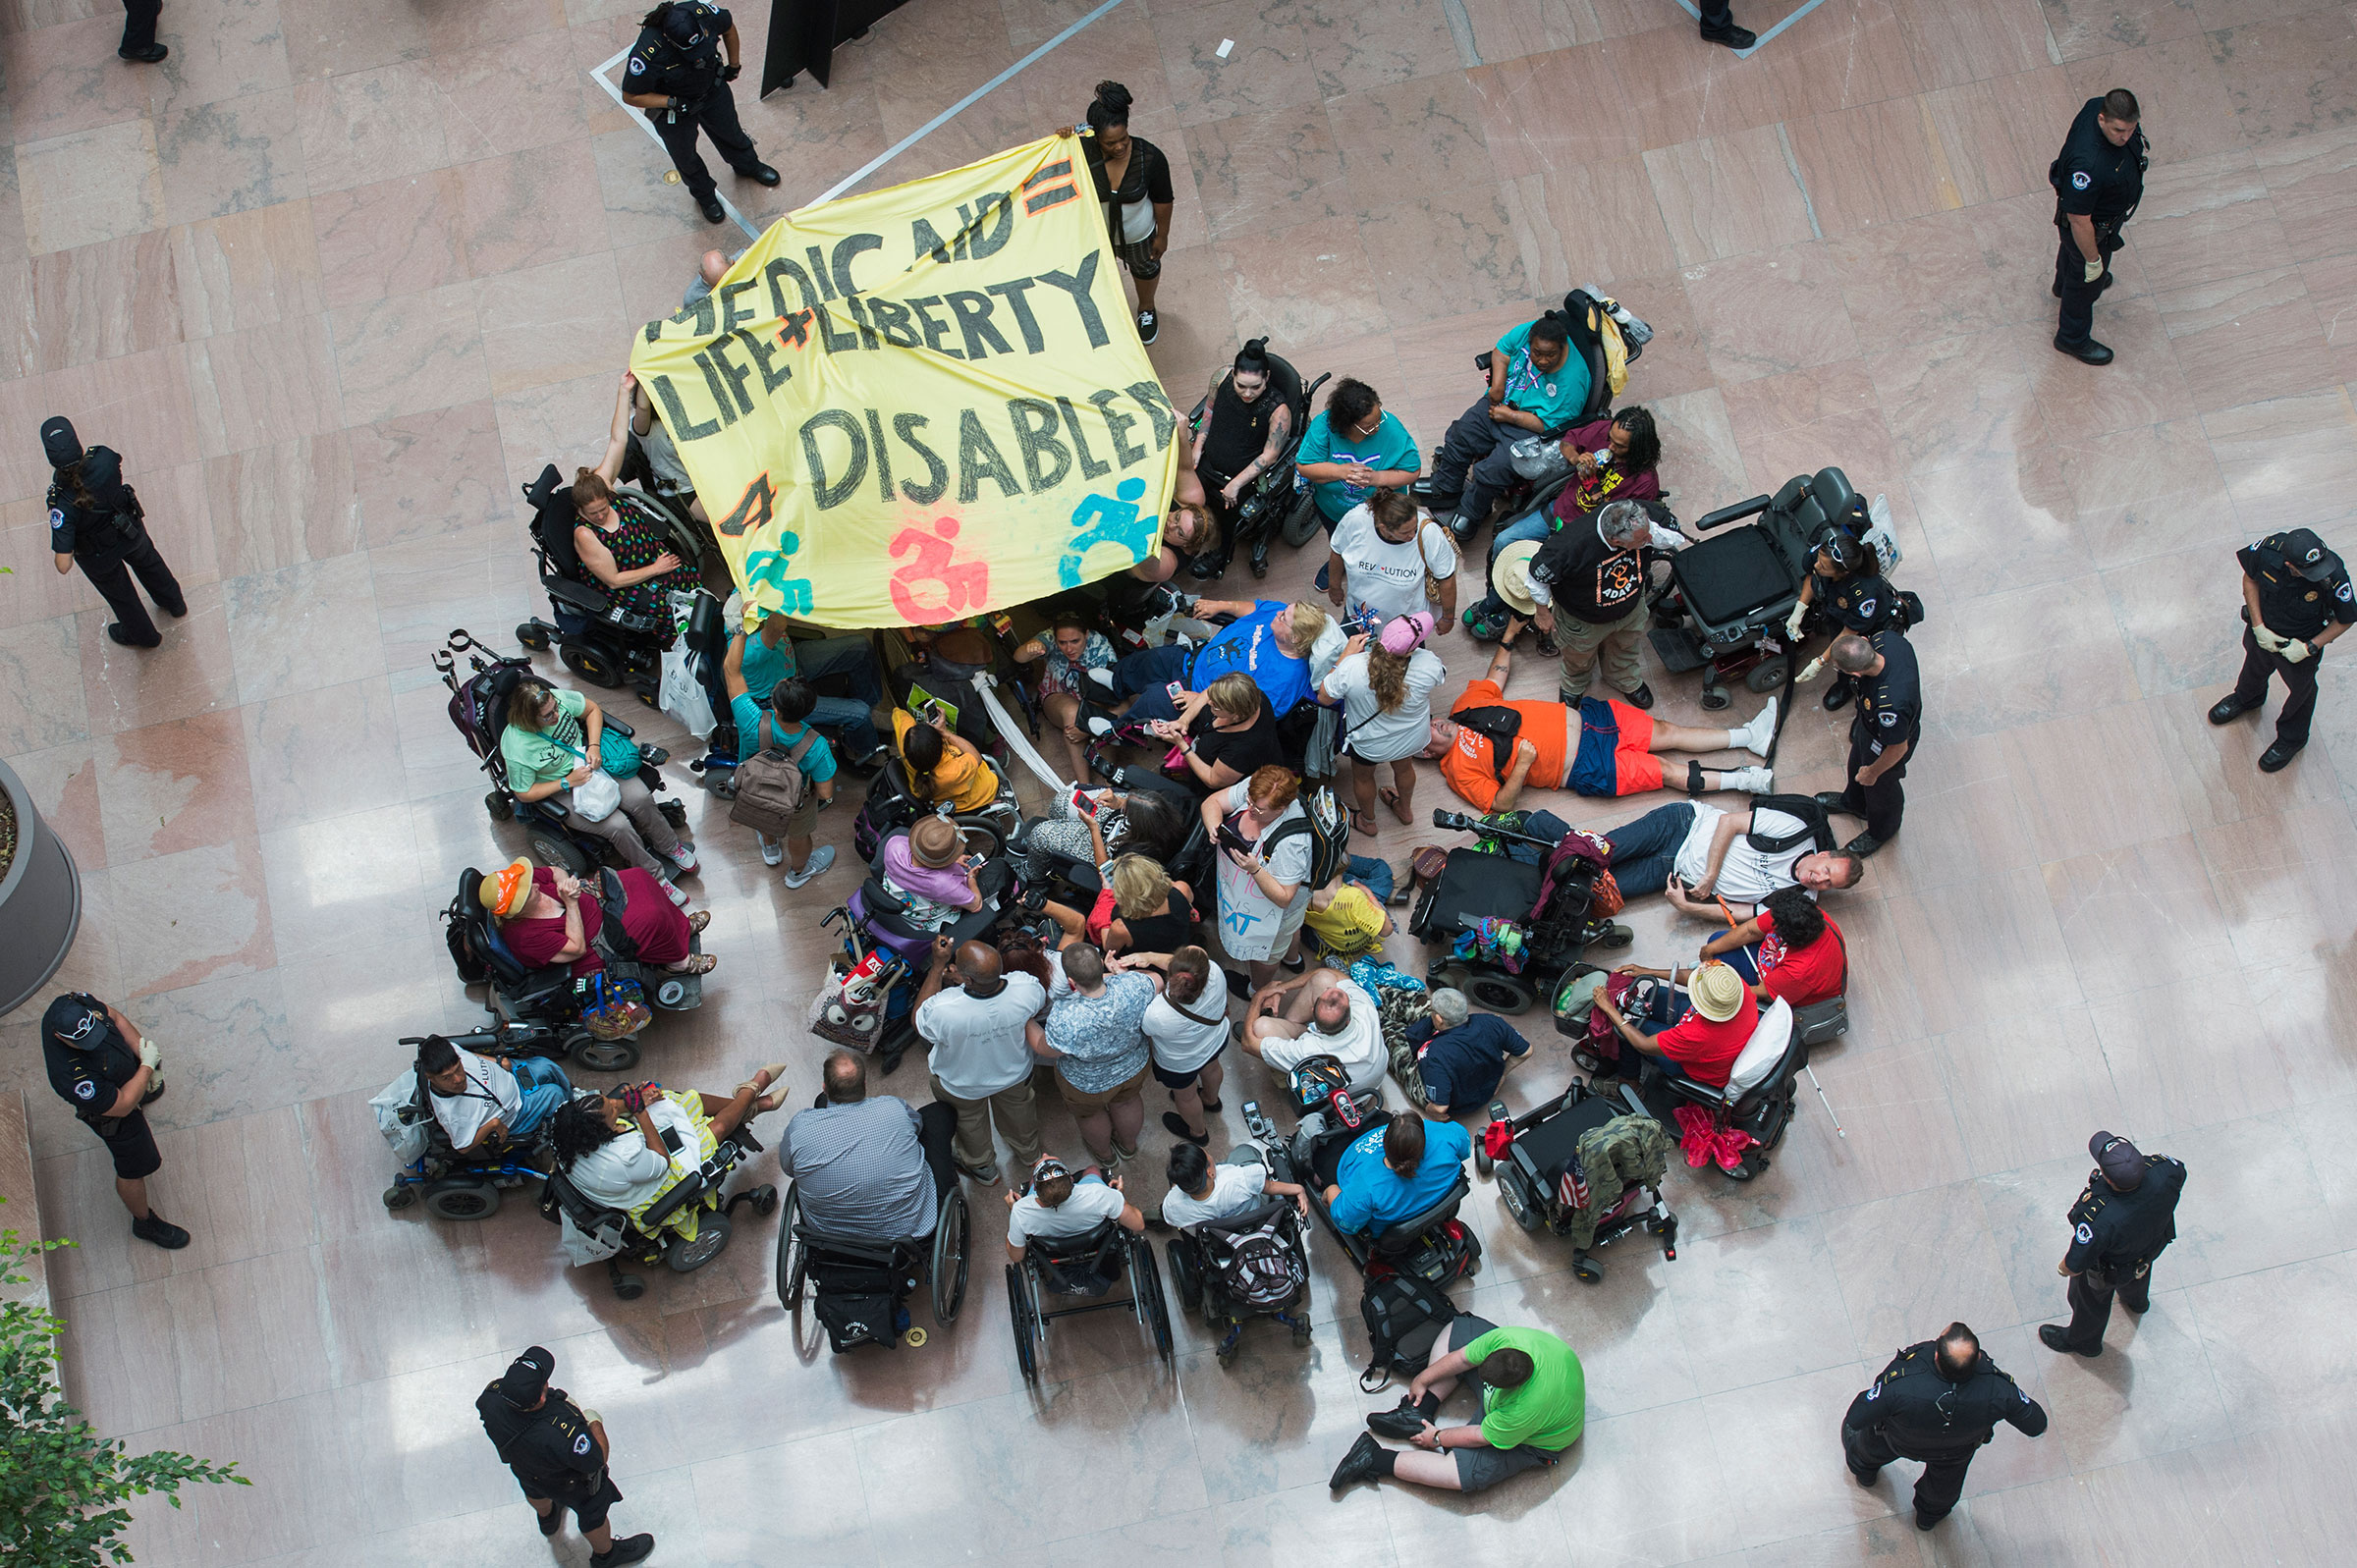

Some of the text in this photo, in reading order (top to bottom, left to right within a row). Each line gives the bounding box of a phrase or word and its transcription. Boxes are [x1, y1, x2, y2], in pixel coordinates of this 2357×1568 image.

[653, 328, 794, 442] LIFE
[818, 249, 1113, 361] LIBERTY
[719, 380, 1178, 538] 4 DISABLED
[1602, 574, 1637, 599] ADAPT
